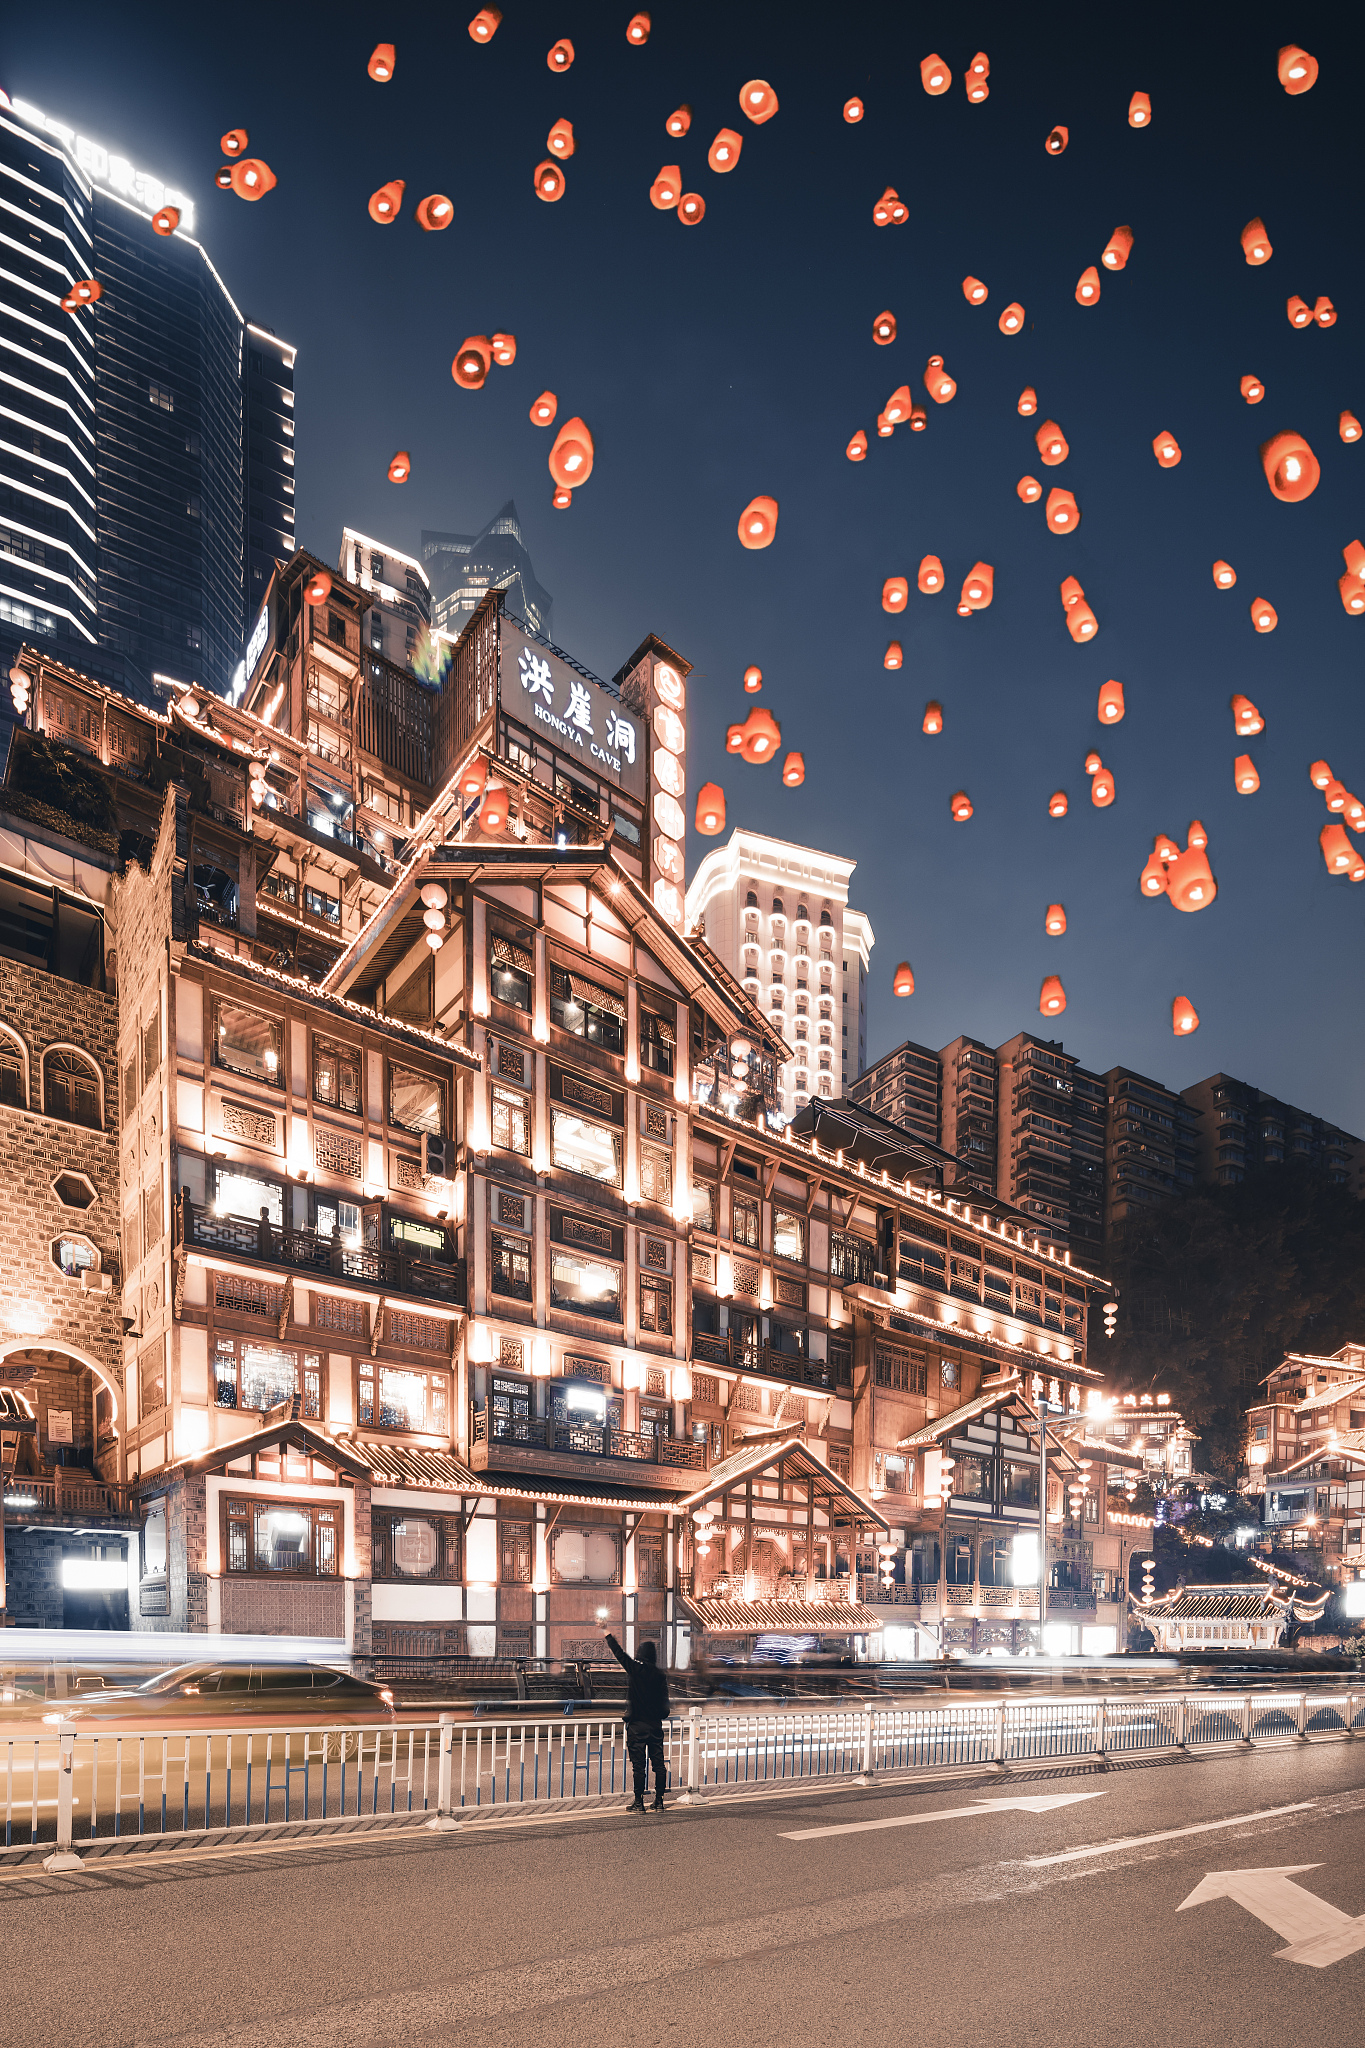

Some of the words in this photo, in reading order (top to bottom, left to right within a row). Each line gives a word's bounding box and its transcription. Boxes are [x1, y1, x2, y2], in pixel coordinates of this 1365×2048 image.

[518, 646, 635, 764] 洪崖洞
[534, 702, 583, 747] HONGYA
[590, 742, 621, 772] CAVE
